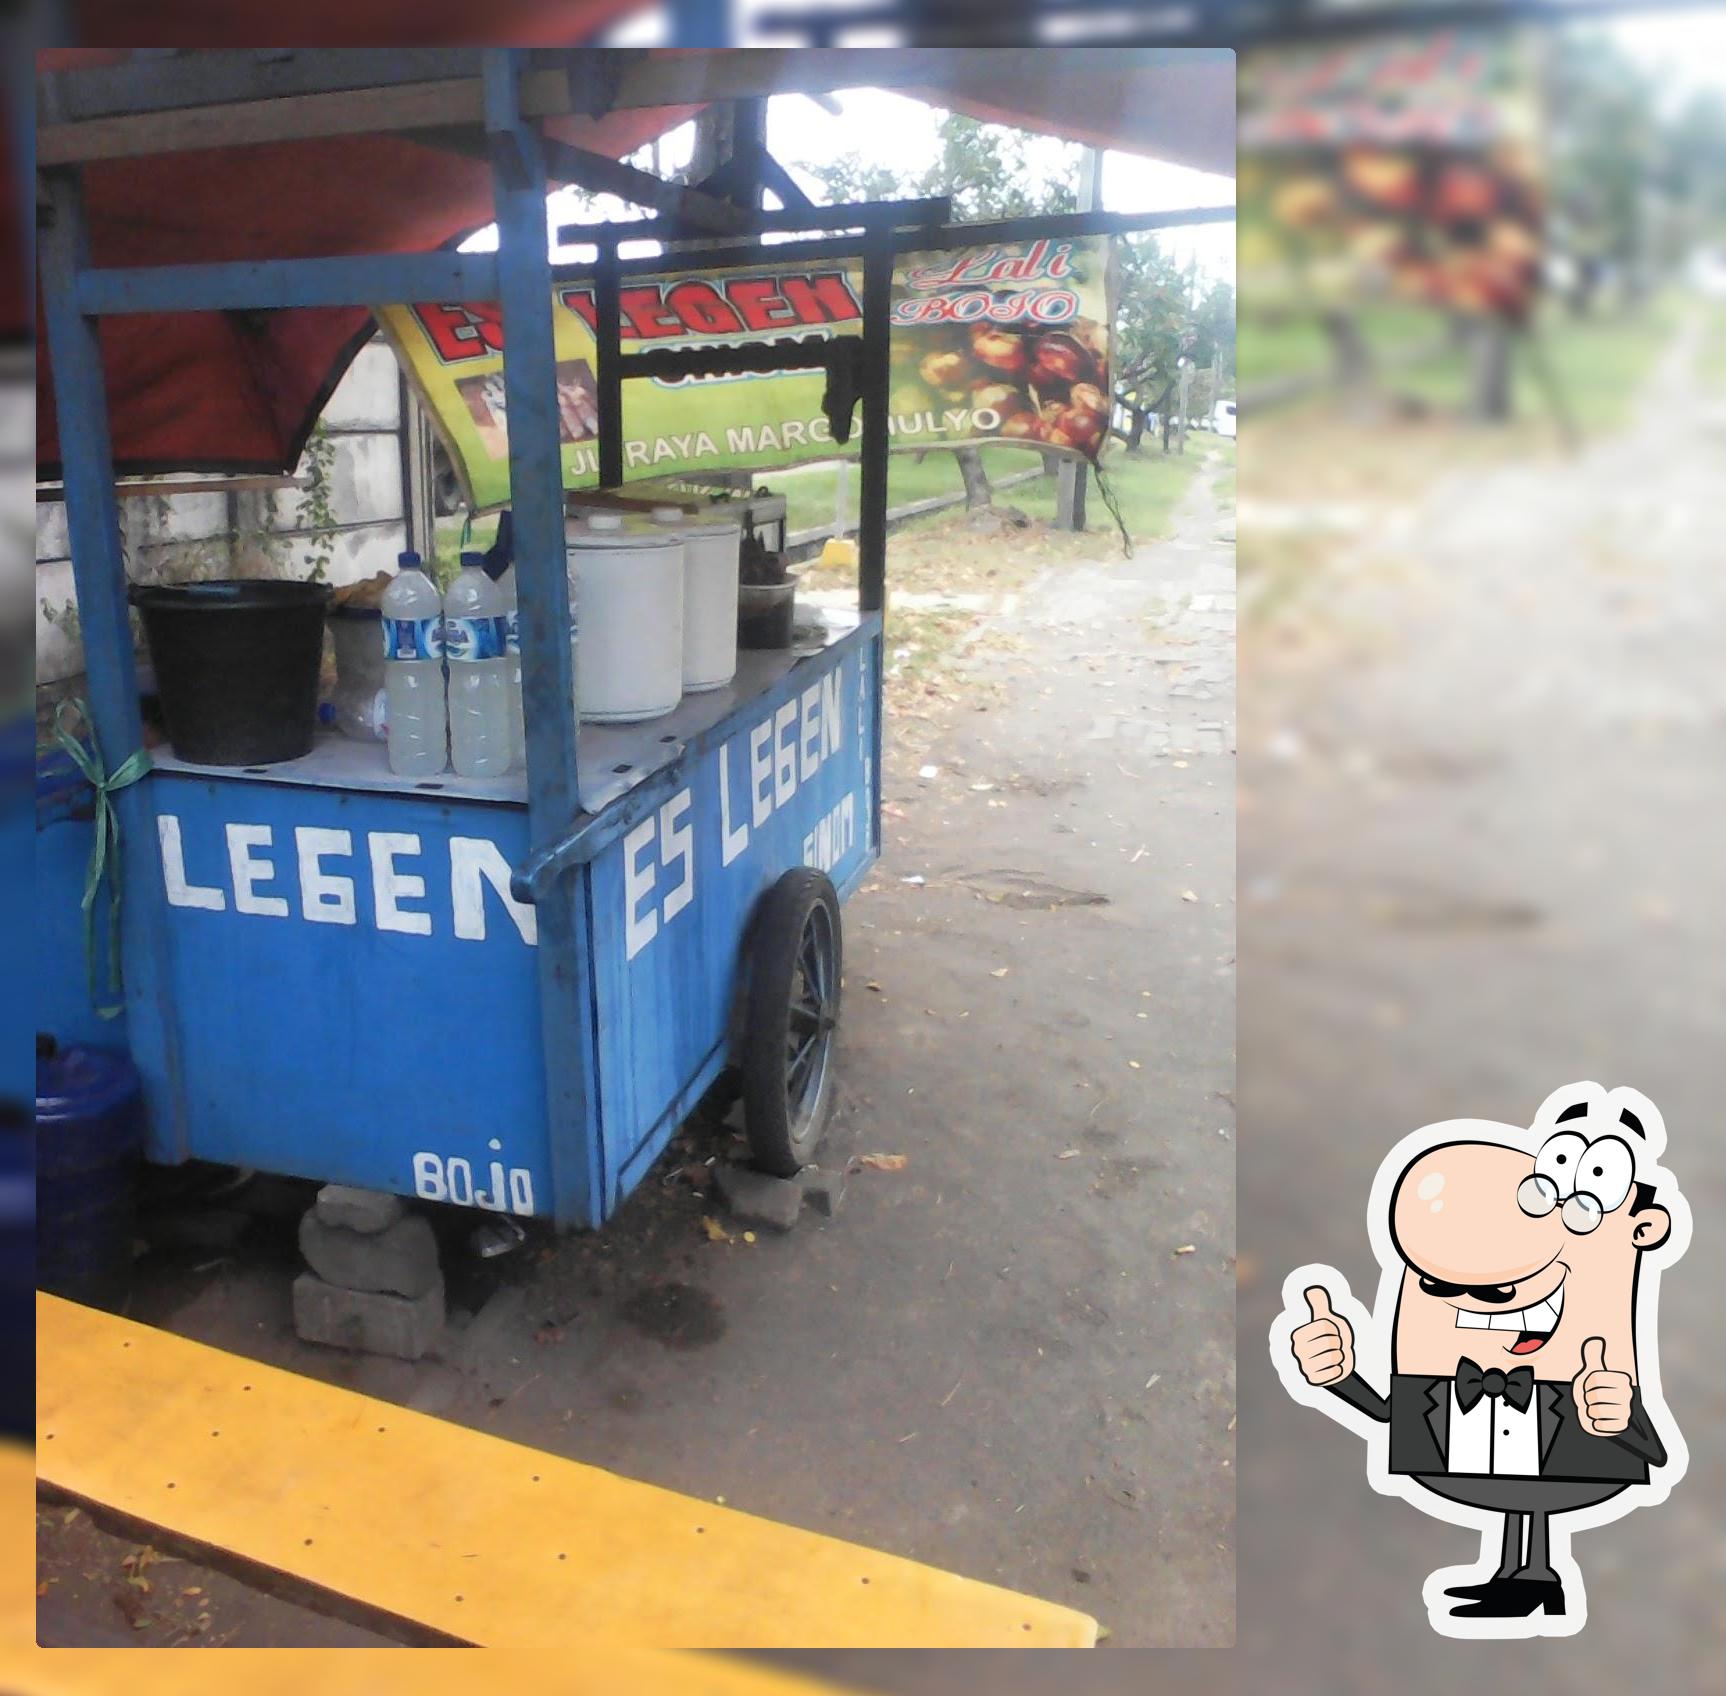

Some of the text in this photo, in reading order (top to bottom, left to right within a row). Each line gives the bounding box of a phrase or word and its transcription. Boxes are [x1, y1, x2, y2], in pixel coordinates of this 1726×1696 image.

[910, 239, 1073, 290] Lali
[624, 432, 719, 468] RAYA
[726, 407, 1001, 454] MARGOULYO
[624, 787, 694, 961] ES
